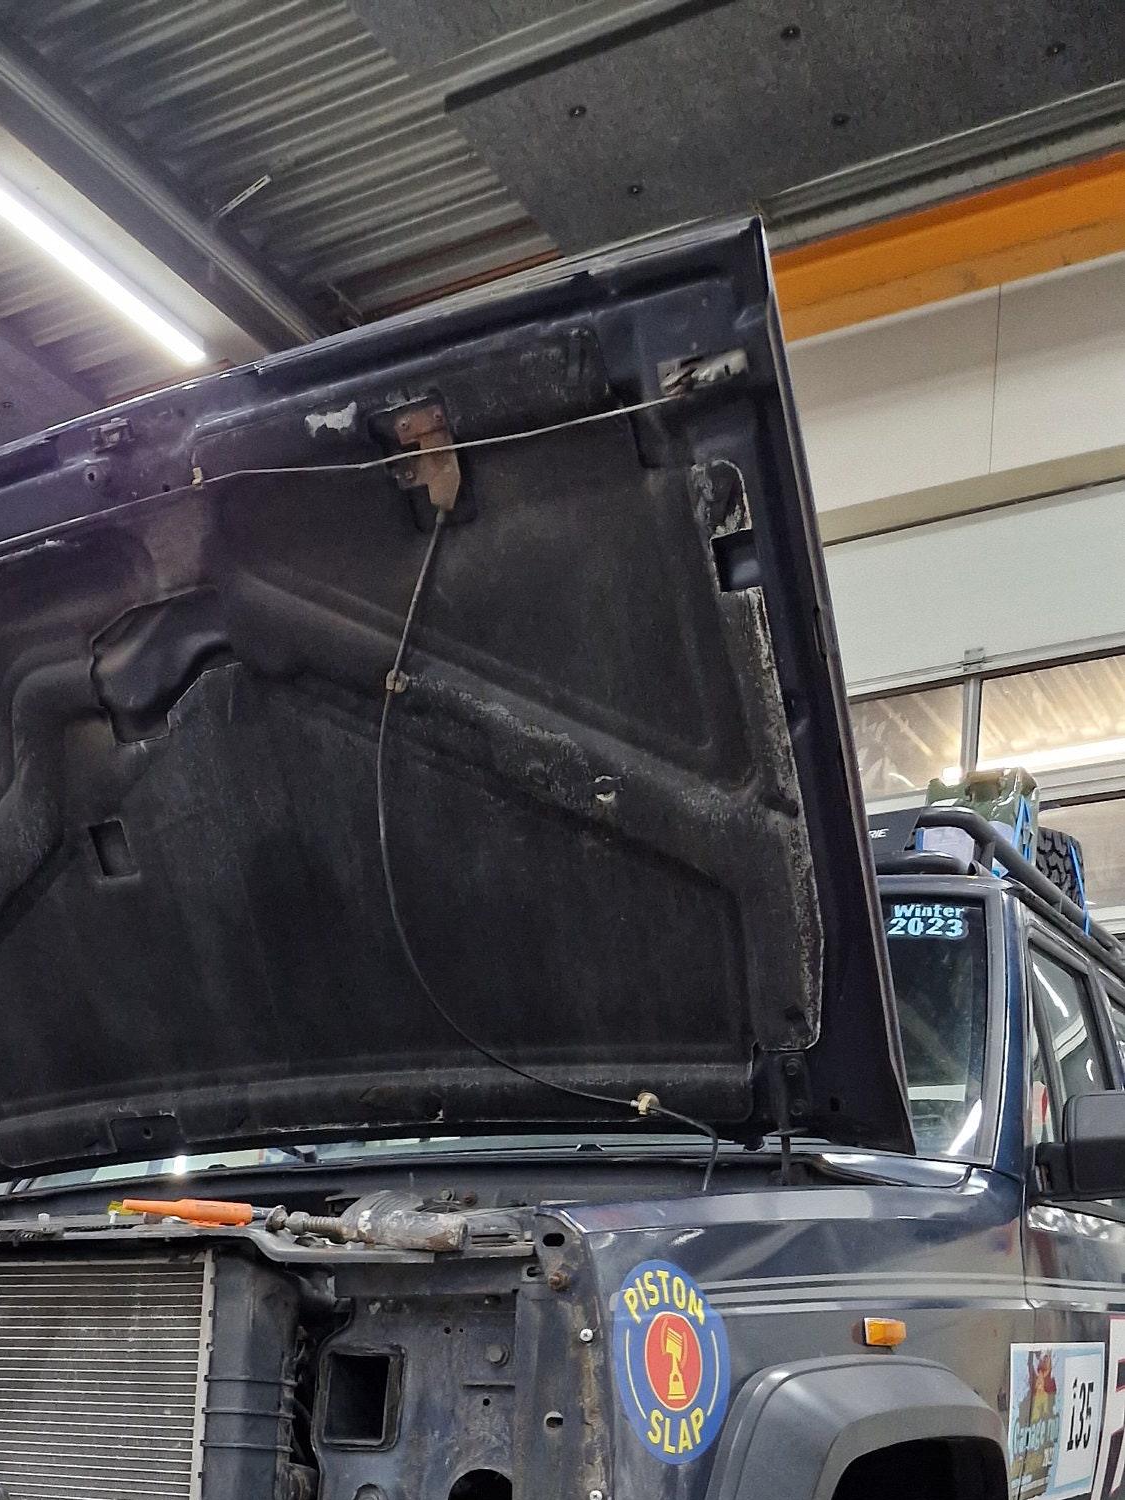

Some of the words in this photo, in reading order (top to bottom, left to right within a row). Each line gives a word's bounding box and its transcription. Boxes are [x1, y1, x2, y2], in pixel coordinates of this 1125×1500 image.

[887, 917, 964, 937] 2023
[893, 903, 965, 918] Winter
[623, 1269, 705, 1326] PISTON
[647, 1406, 705, 1454] SLAP
